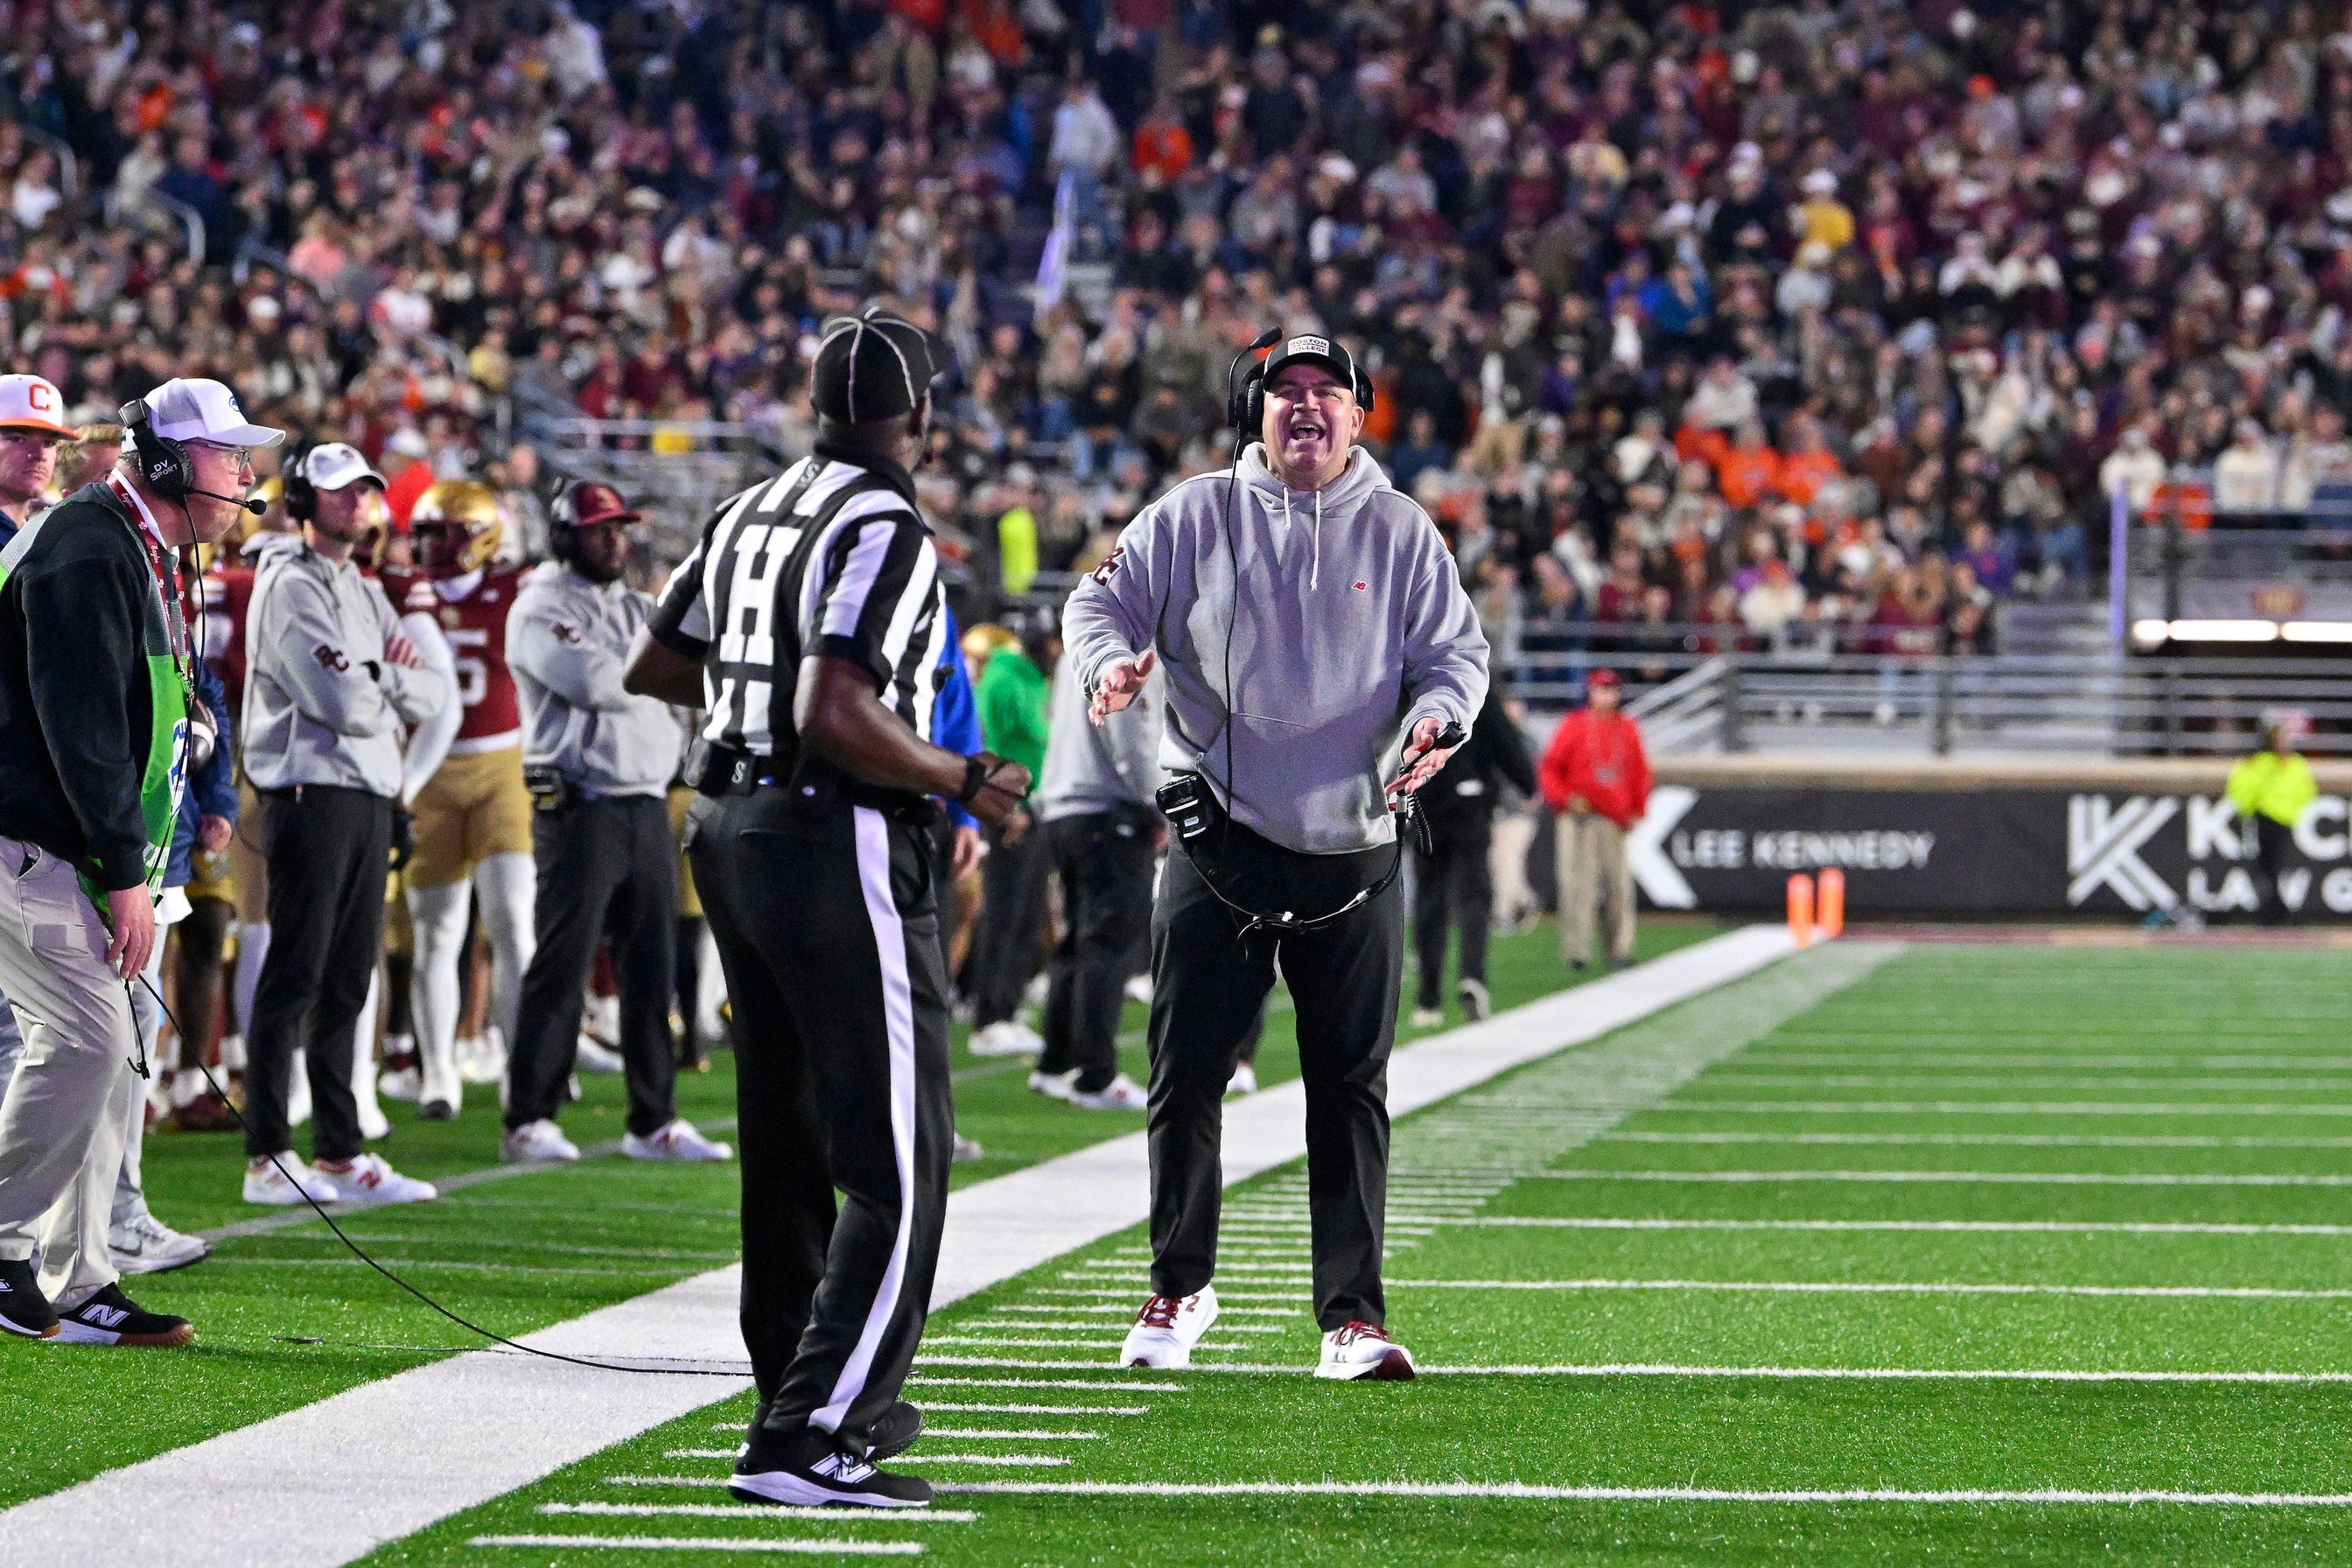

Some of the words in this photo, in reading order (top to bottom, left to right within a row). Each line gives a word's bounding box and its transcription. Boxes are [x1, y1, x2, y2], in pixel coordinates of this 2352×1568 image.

[1290, 339, 1327, 347] BOSTON
[29, 383, 51, 412] C
[153, 459, 168, 472] DV
[719, 524, 803, 667] H
[313, 644, 350, 672] BC
[1670, 830, 1746, 869] LEE
[1752, 830, 1936, 870] KENNEDY
[2066, 794, 2180, 913] K
[79, 1303, 130, 1328] N
